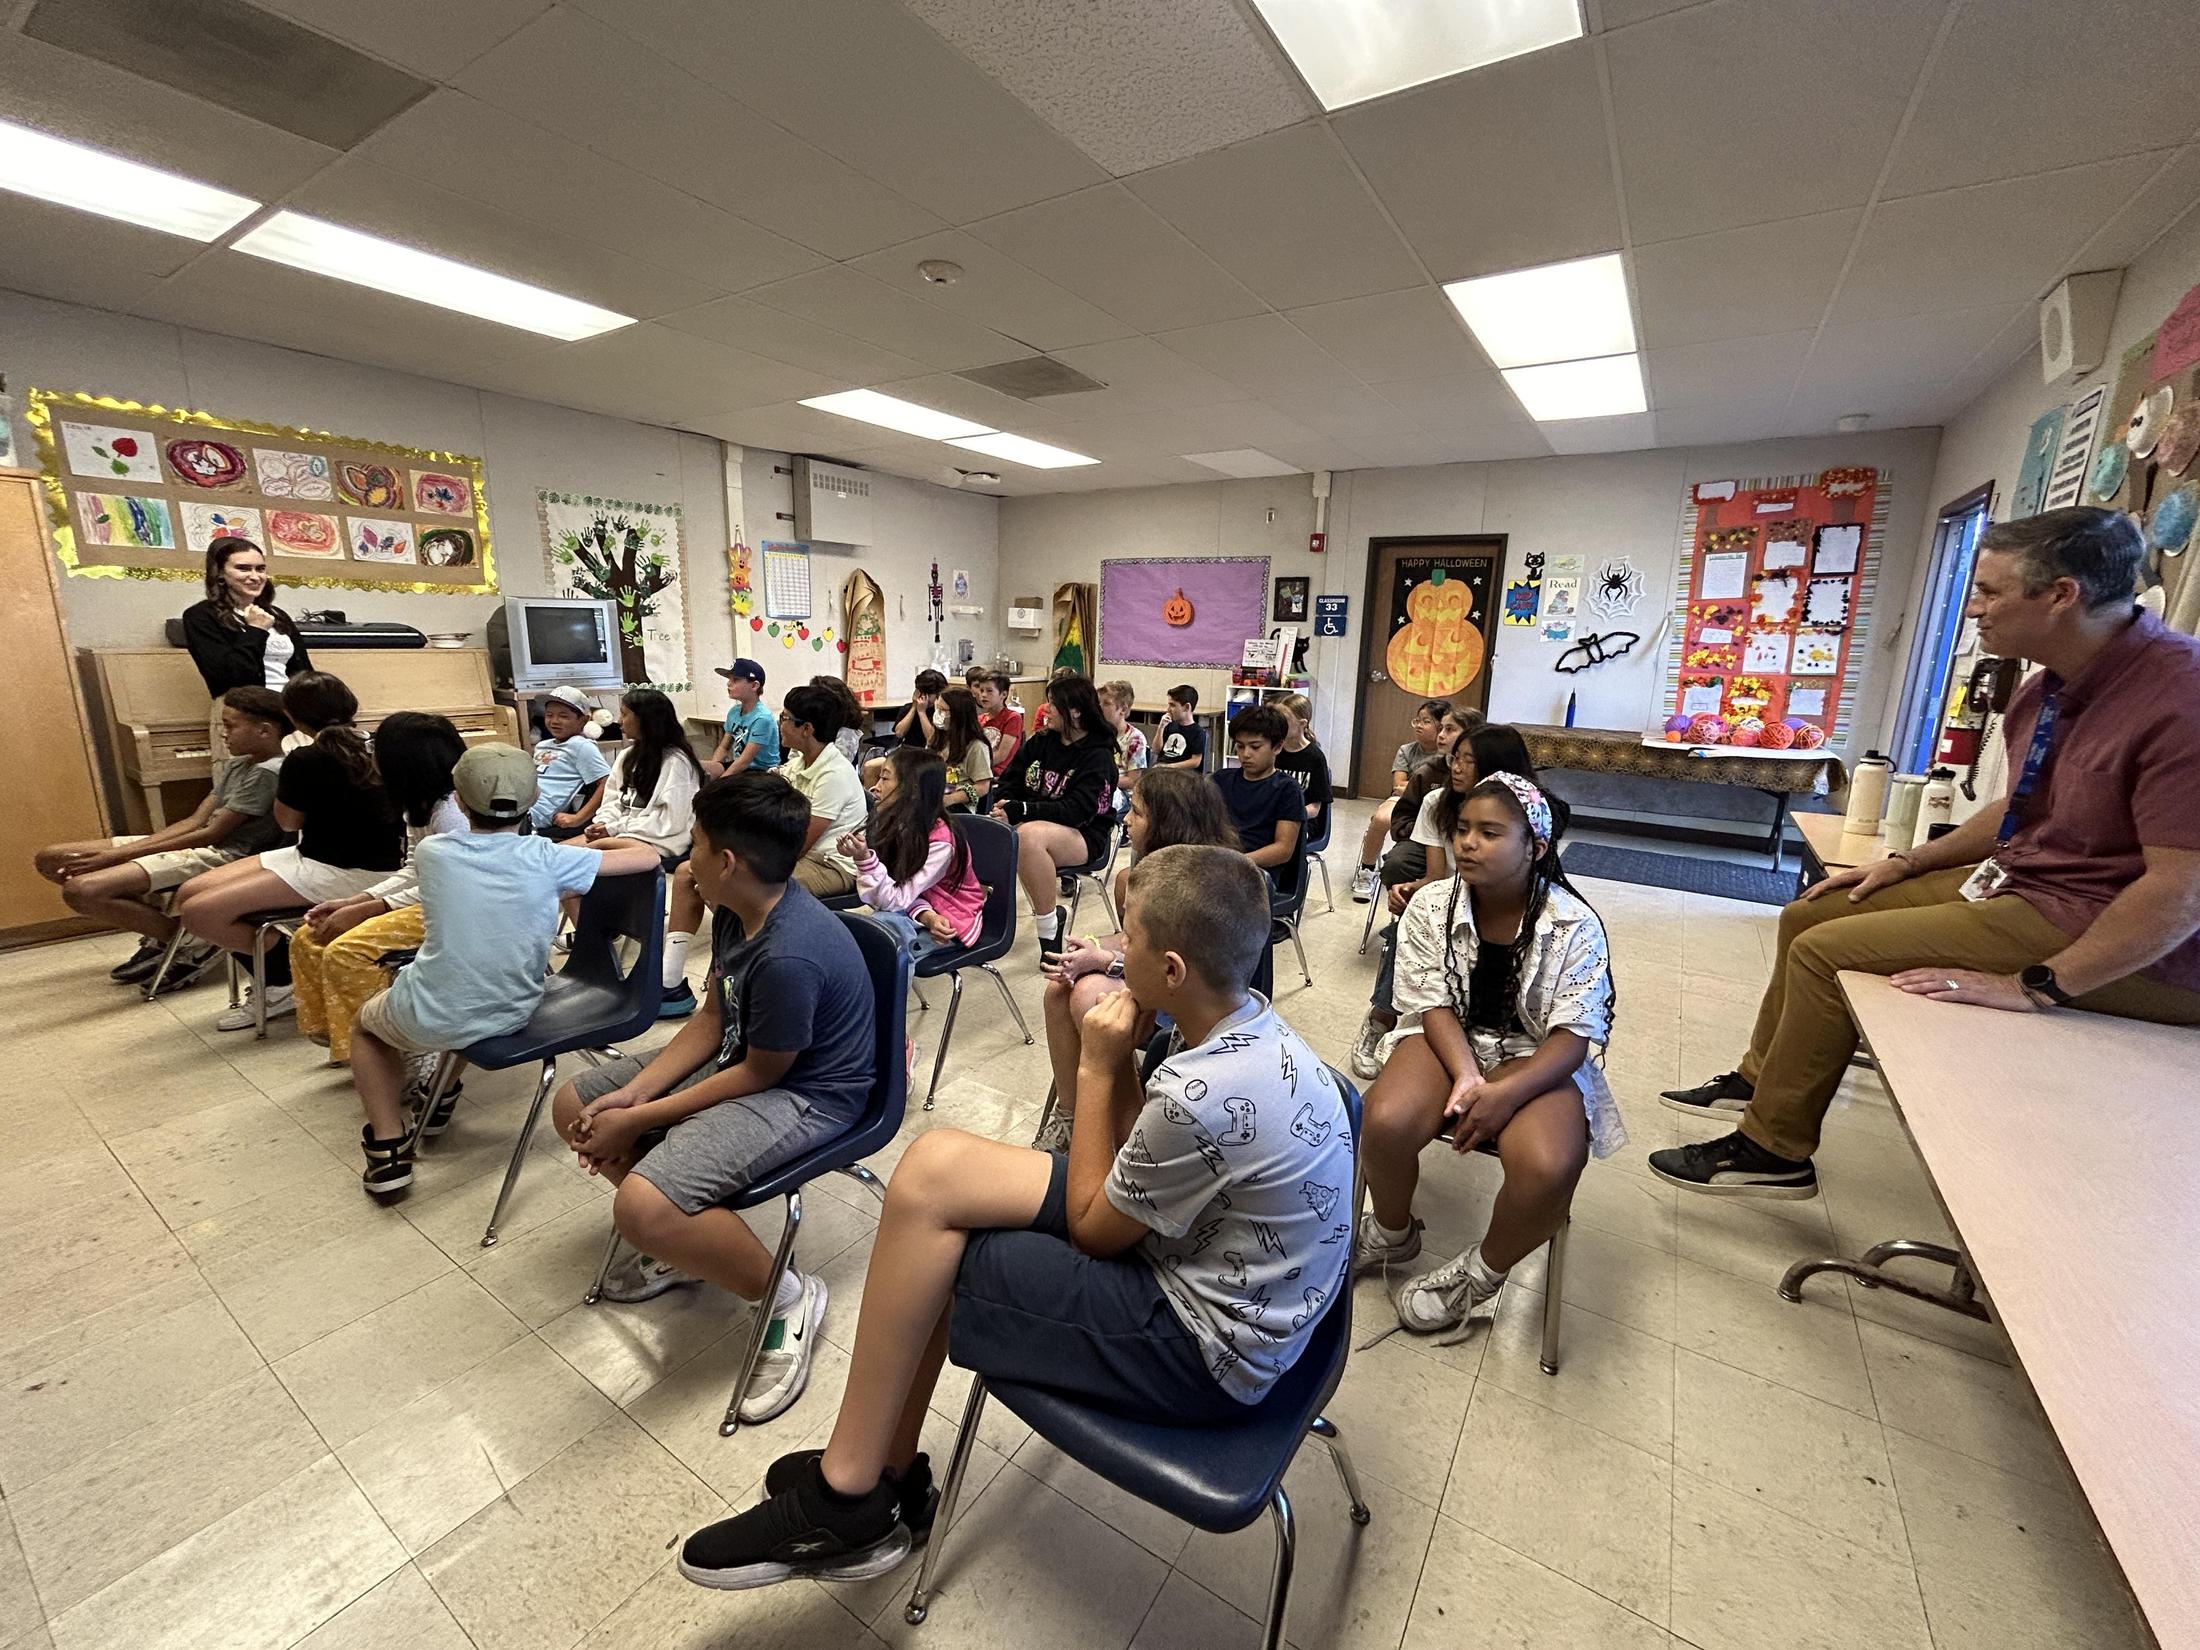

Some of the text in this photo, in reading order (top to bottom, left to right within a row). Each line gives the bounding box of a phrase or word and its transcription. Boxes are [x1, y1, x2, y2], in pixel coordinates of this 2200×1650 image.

[1401, 558, 1488, 568] HAPPY HALLOWEEN
[1549, 578, 1577, 589] Read
[1325, 603, 1338, 611] 33
[646, 628, 671, 641] Tree
